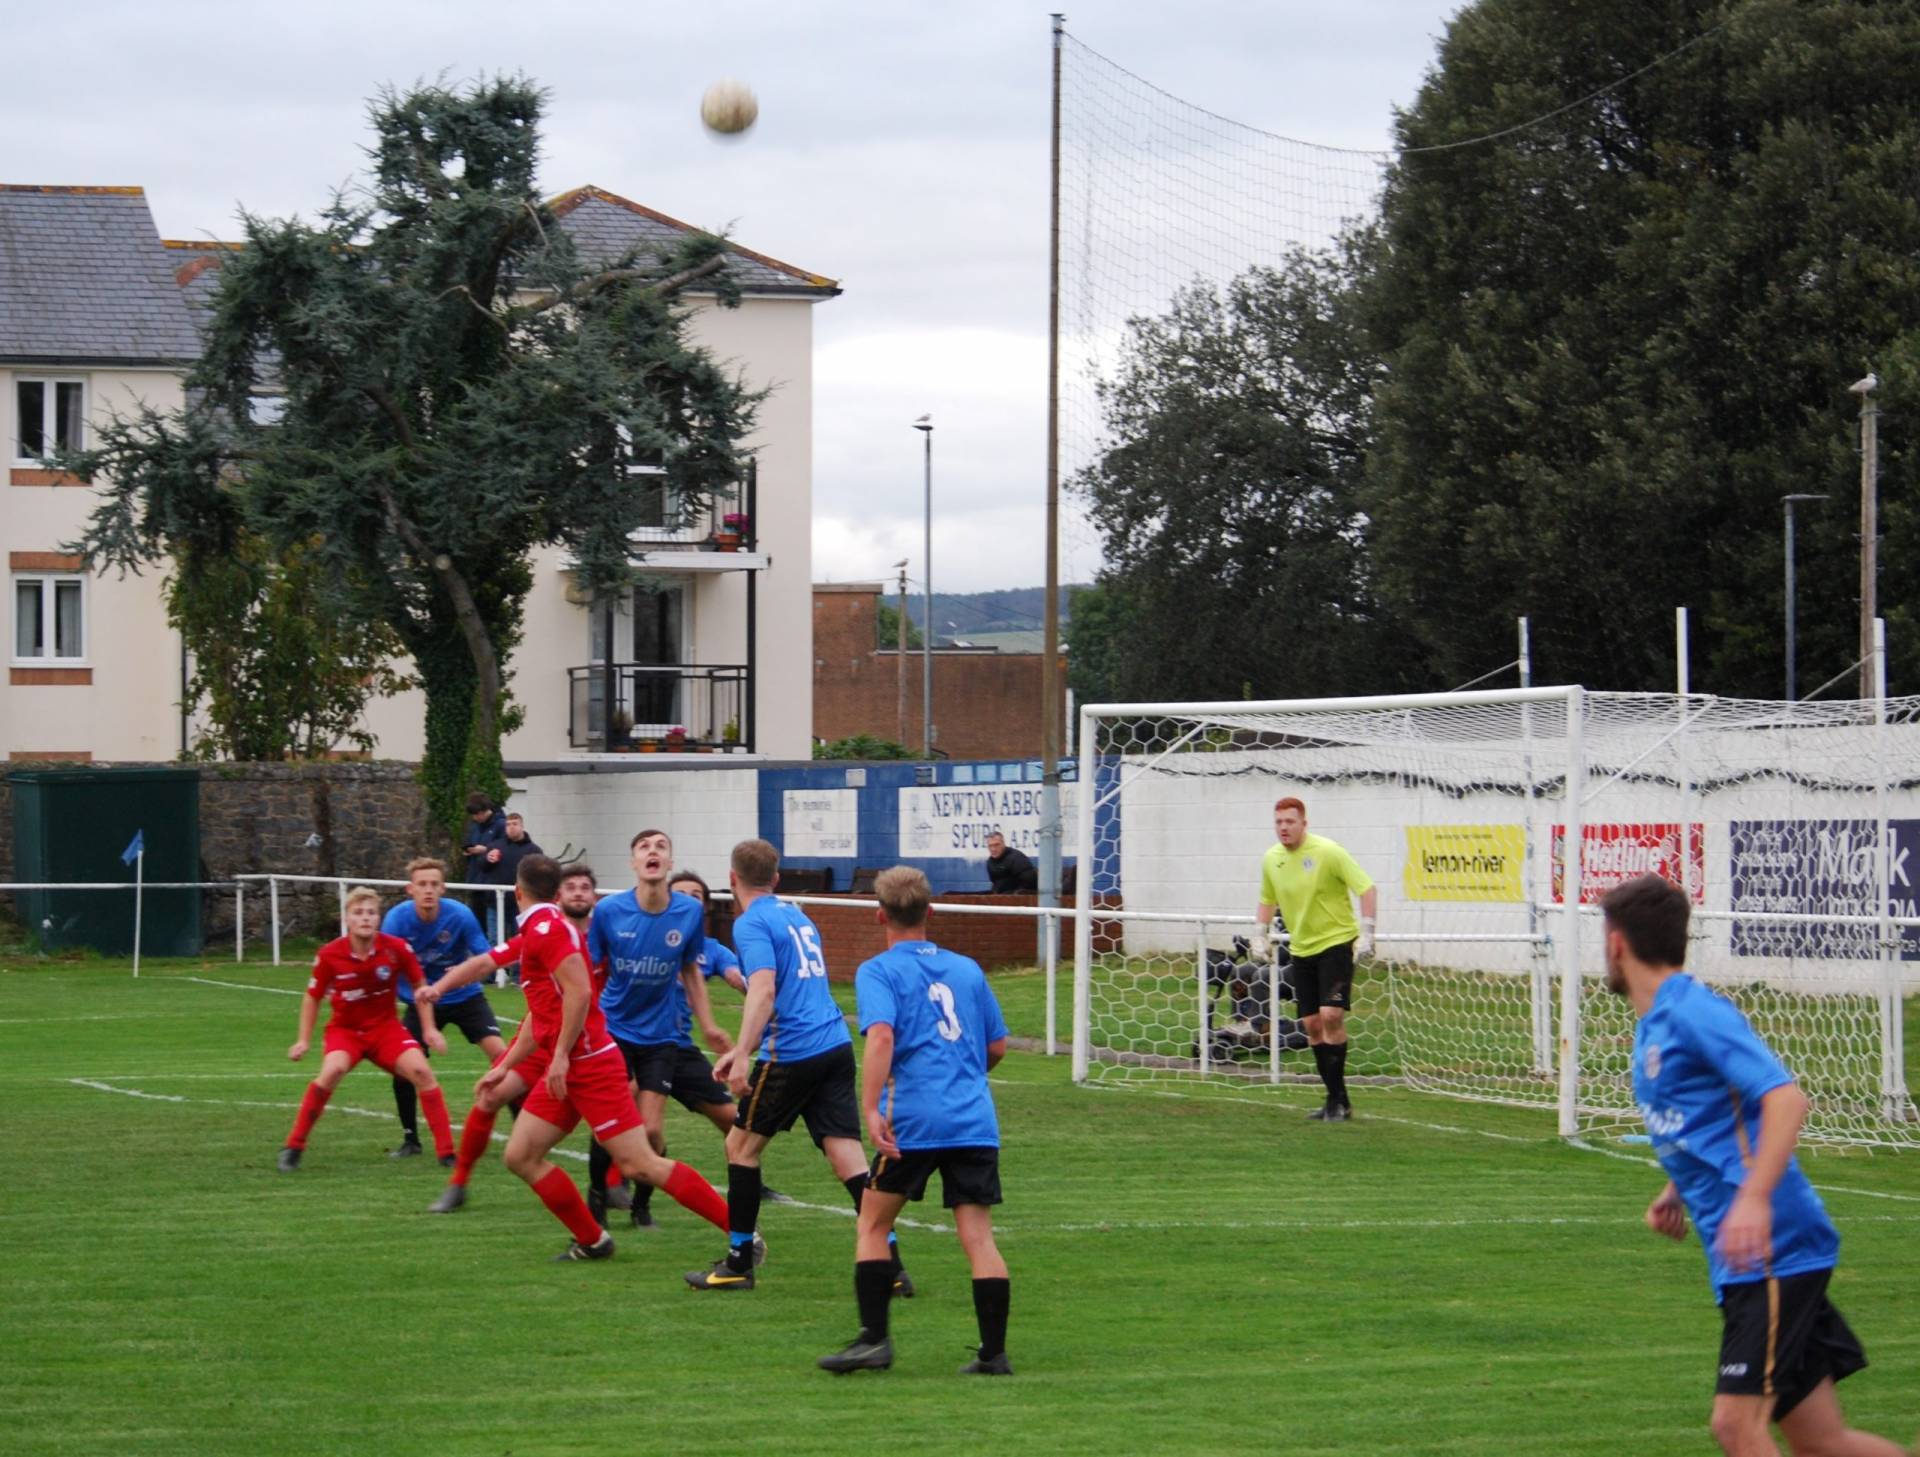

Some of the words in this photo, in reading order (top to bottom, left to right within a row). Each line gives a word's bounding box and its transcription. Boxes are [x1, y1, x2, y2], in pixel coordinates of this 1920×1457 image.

[932, 791, 996, 818] NEWTON
[1000, 789, 1043, 817] ABBO
[1422, 849, 1506, 873] lemon-river
[788, 925, 825, 979] 15
[928, 982, 962, 1042] 3
